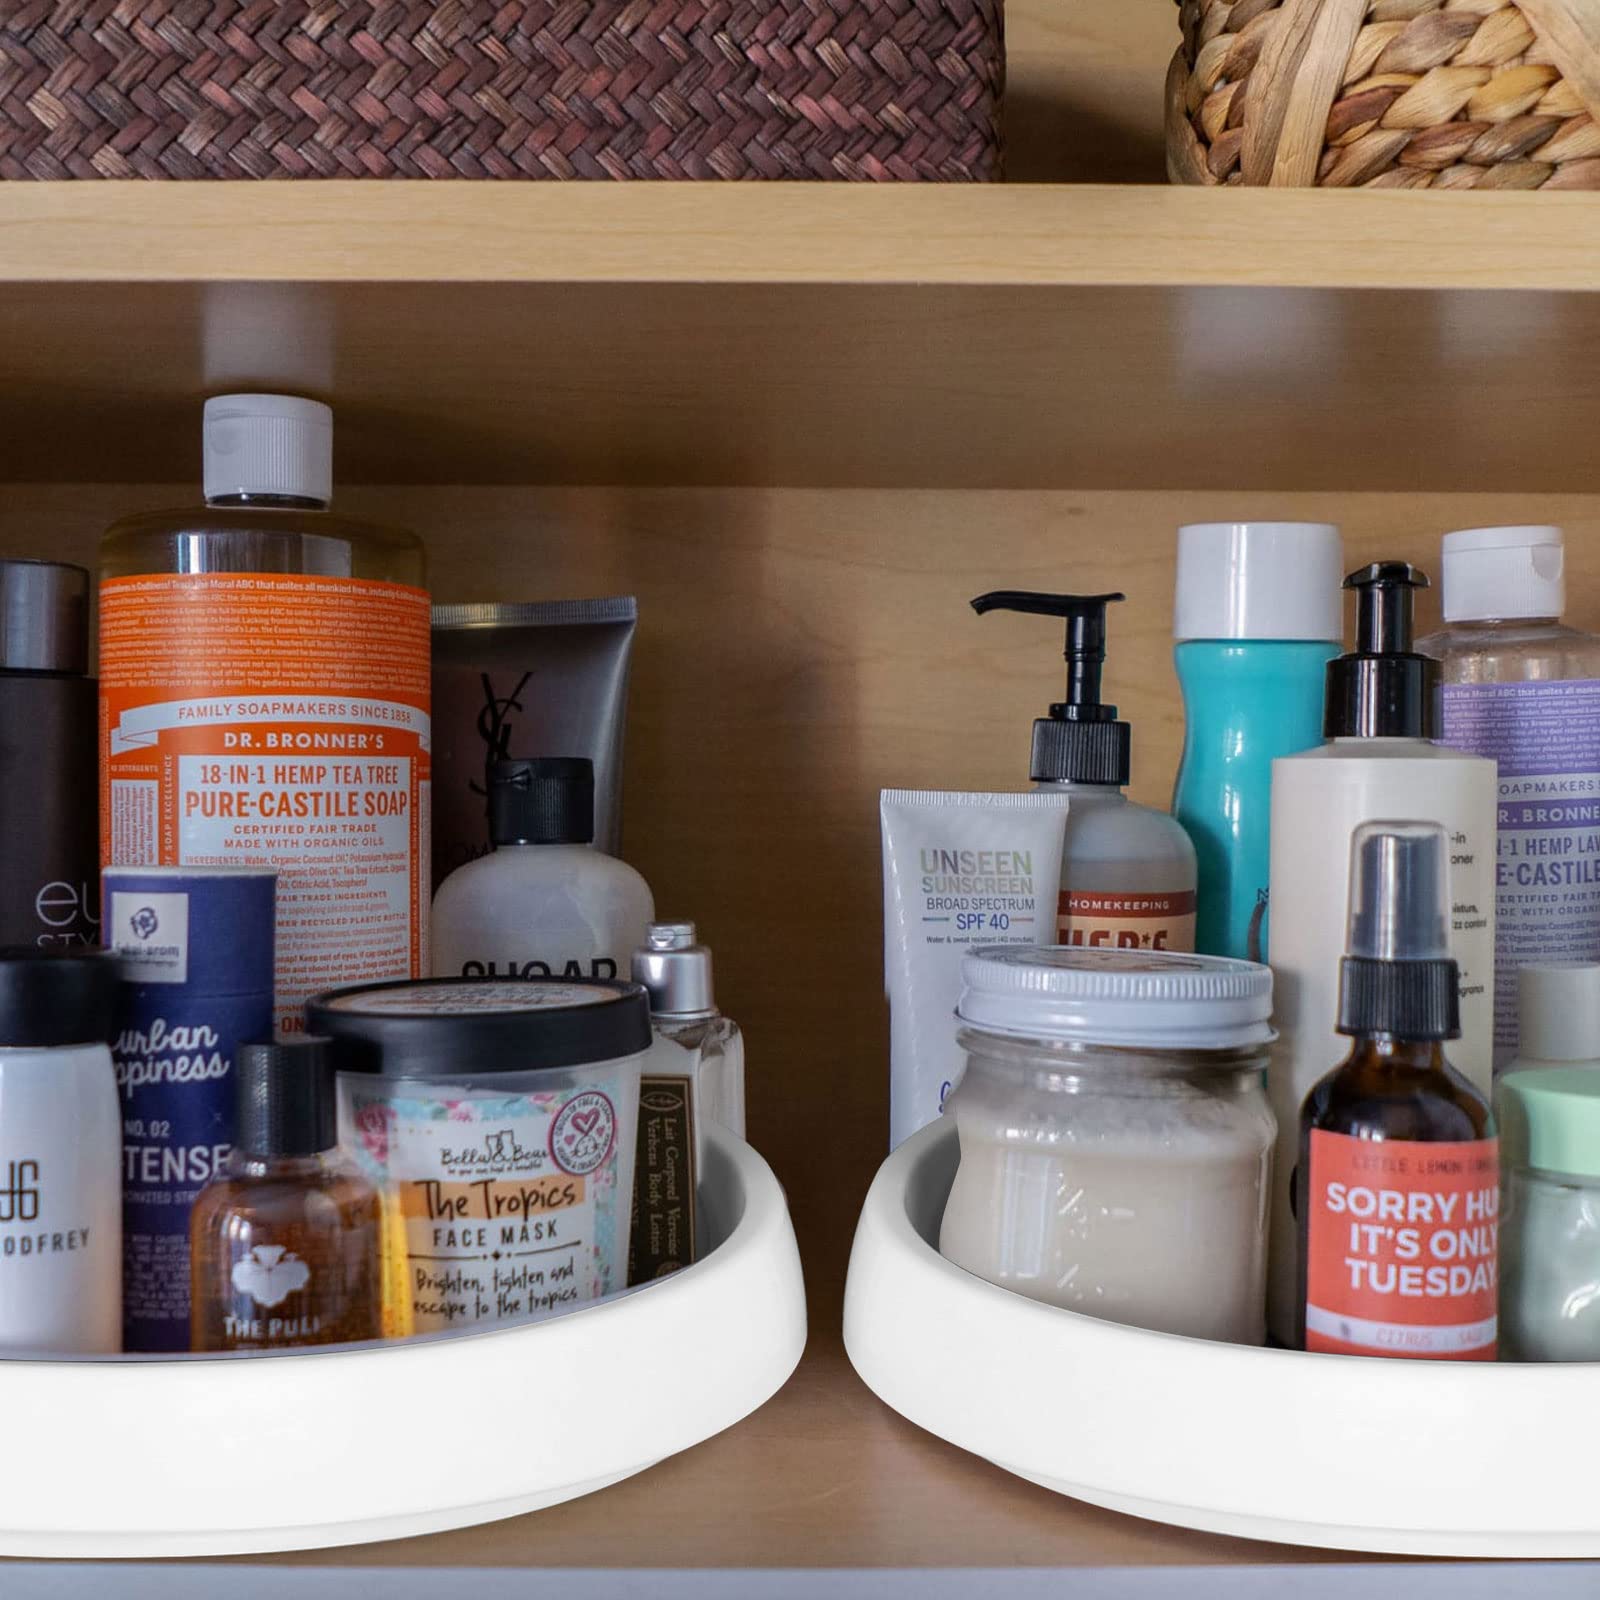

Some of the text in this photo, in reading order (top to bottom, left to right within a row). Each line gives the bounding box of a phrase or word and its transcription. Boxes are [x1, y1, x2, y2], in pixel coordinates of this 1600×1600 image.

[178, 703, 232, 719] FAMILY
[237, 702, 346, 716] SOAPMAKERS
[351, 704, 388, 719] SINCE
[224, 732, 384, 749] DR. BRONNER'S
[200, 764, 398, 785] 18-IN-1 HEMP TEA TREE
[164, 753, 172, 820] EXCELLENCE
[185, 791, 407, 818] PURE-CASTILE SOAP
[164, 823, 172, 852] SOAP
[234, 823, 377, 834] CERTIFIED FAIR TRADE
[224, 837, 384, 849] MADE WITH ORGANIC OILS
[1525, 836, 1572, 856] HEMP
[244, 855, 270, 866] Water,
[271, 855, 301, 866] Organic
[919, 848, 1032, 876] UNSEEN
[278, 868, 306, 878] Organic
[921, 876, 1033, 895] SUNSCREEN
[302, 894, 331, 902] TRADE
[335, 890, 387, 901] INGREDIENTS
[926, 897, 1035, 911] BROAD SPECTRUM
[1068, 899, 1170, 911] HOMEKEEPING
[1563, 892, 1587, 902] FAIR
[301, 917, 346, 926] RECYCLED
[350, 915, 381, 924] PLASTIC
[1522, 906, 1554, 916] WITH
[956, 913, 1010, 931] SPF 40
[926, 936, 945, 945] Water
[113, 1017, 219, 1055] urban
[150, 1120, 170, 1138] 02
[412, 1178, 577, 1222] The Tropics
[1326, 1181, 1459, 1223] SORRY
[4, 1228, 90, 1256] ODFREY
[433, 1219, 558, 1248] FACE MASK
[1350, 1223, 1498, 1260] IT'S ONLY
[415, 1256, 574, 1296] Brighten, tighten and
[1345, 1257, 1497, 1297] TUESDAY
[413, 1286, 577, 1320] escape to the tropics
[223, 1315, 262, 1339] THE
